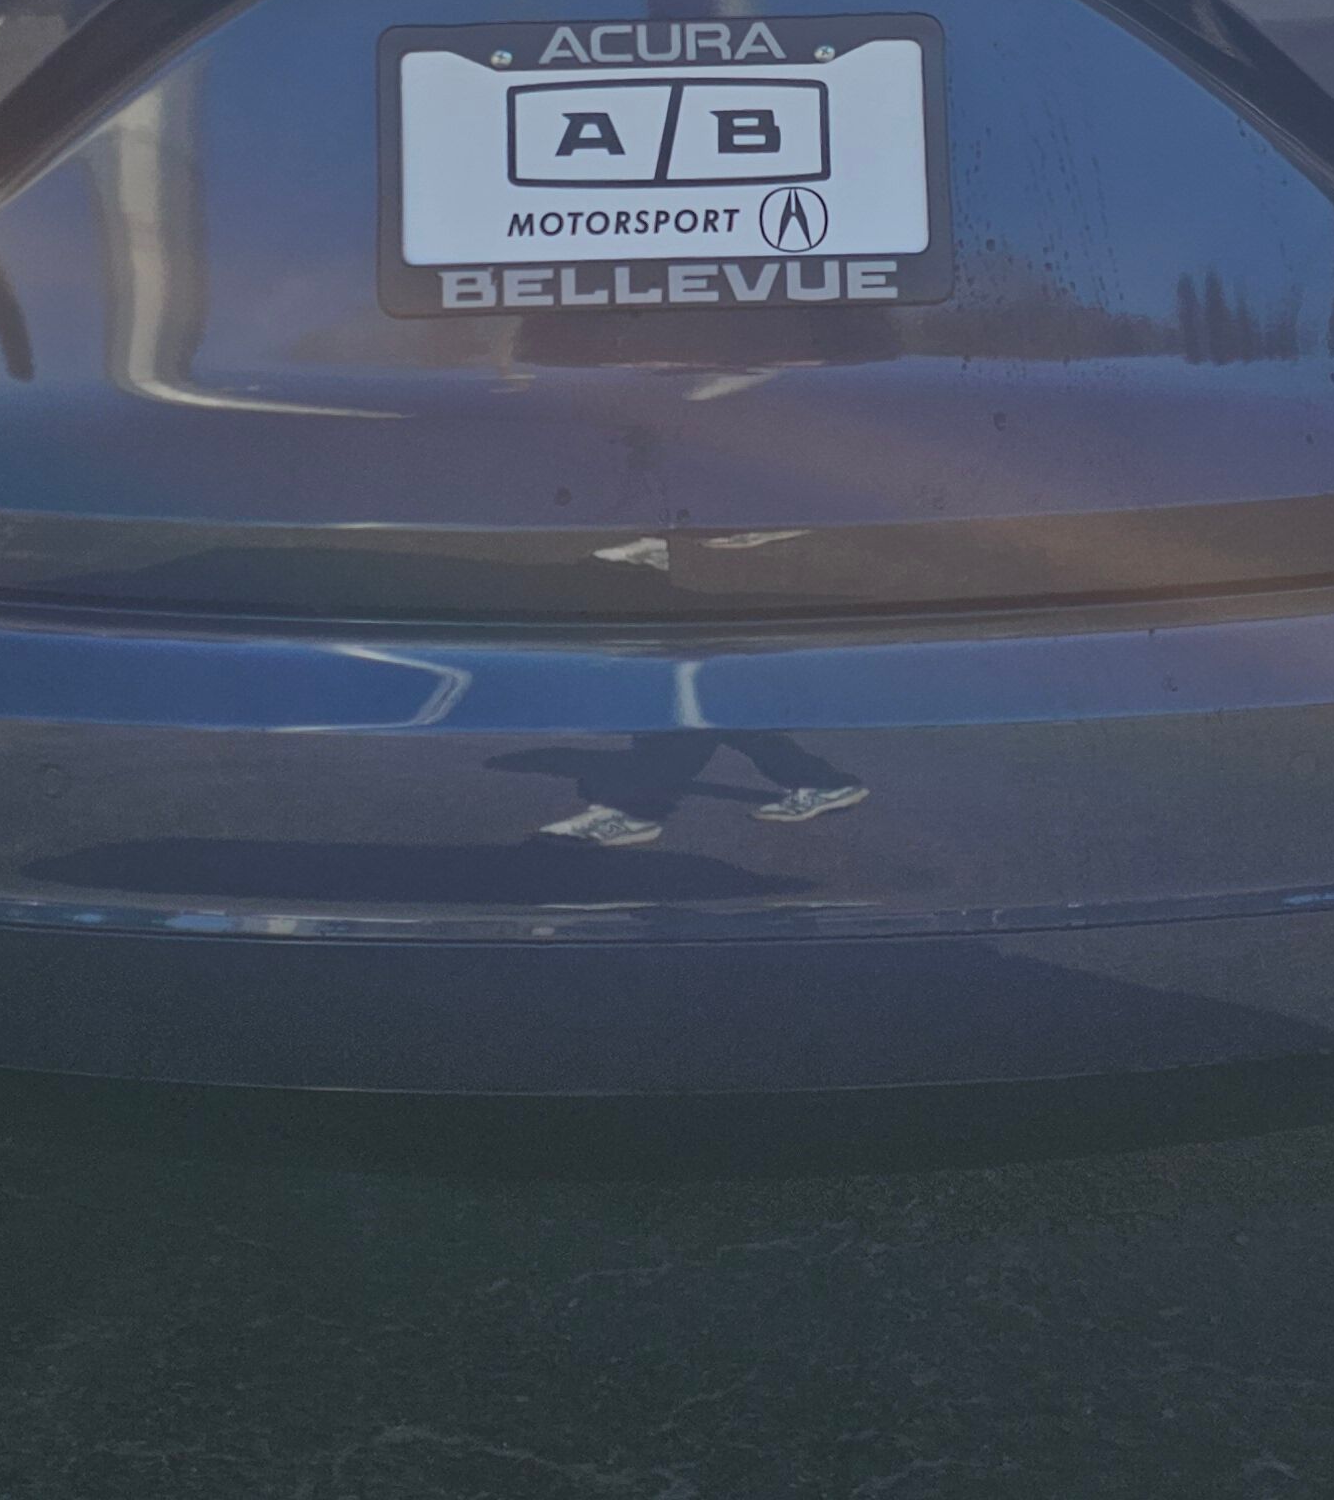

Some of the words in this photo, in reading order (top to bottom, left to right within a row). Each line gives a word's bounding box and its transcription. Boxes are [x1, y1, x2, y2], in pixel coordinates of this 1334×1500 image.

[539, 23, 786, 64] ACURA
[507, 208, 740, 237] MOTORSPORT
[437, 260, 898, 308] BELLEVUE
